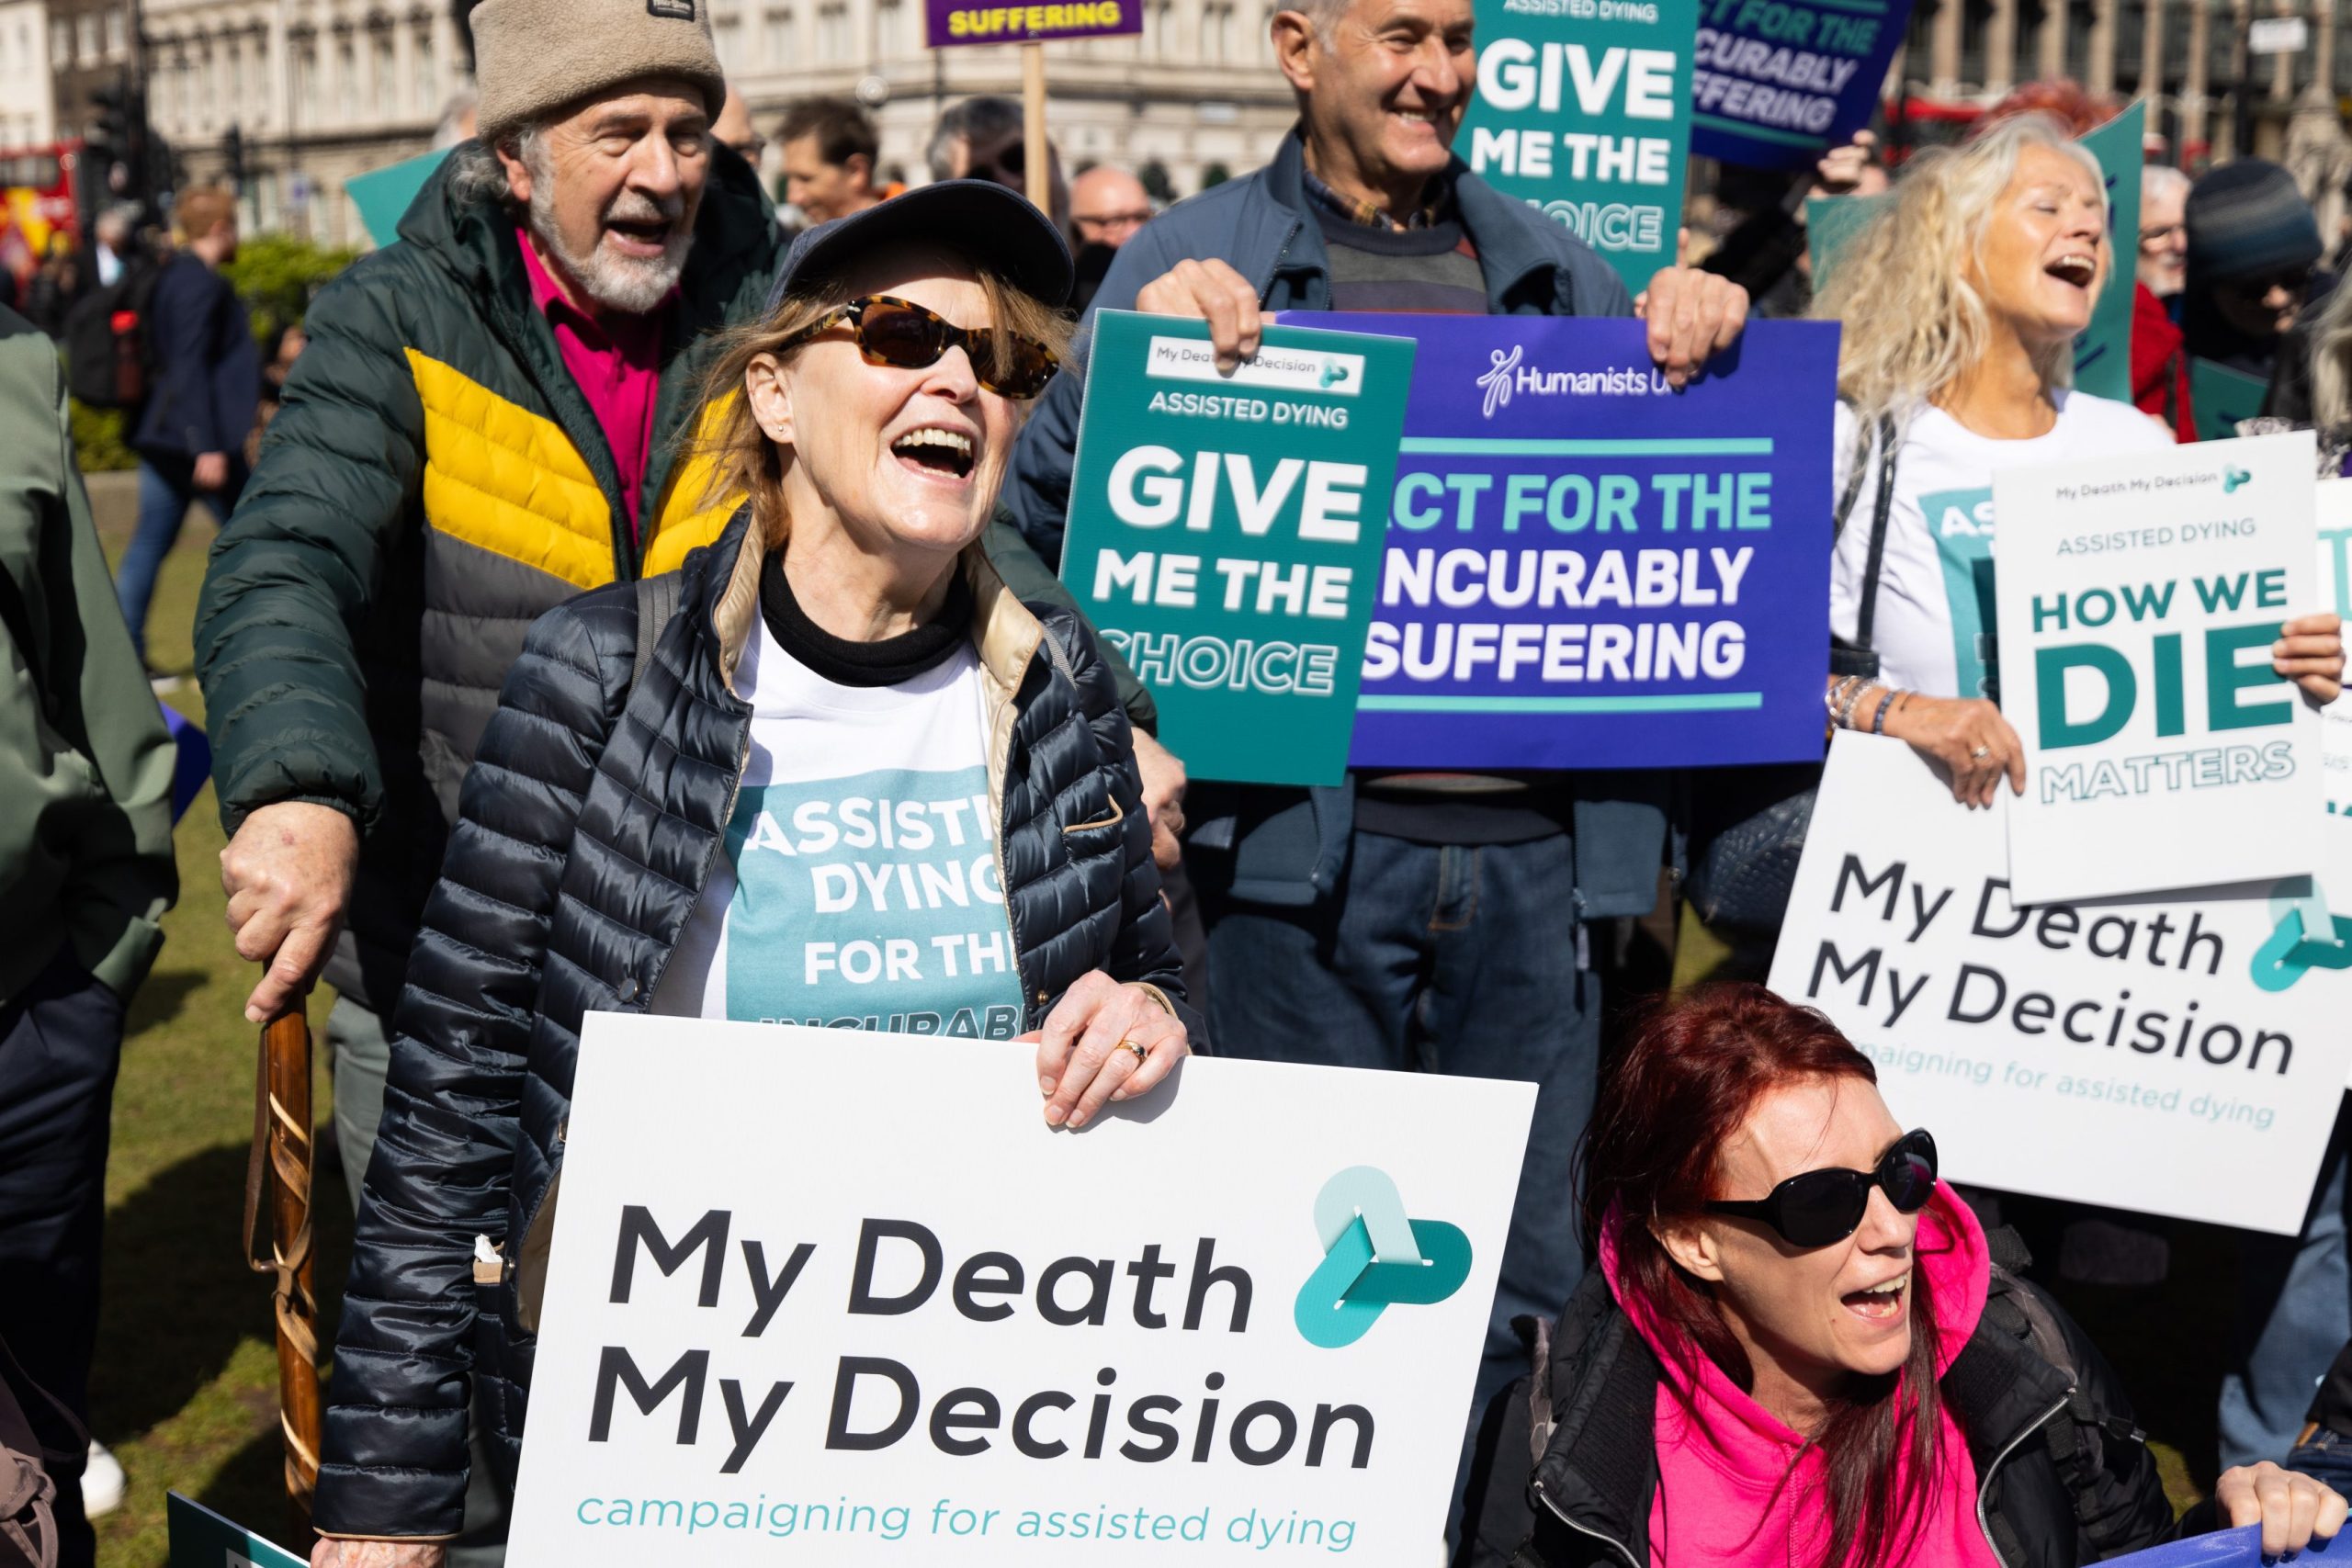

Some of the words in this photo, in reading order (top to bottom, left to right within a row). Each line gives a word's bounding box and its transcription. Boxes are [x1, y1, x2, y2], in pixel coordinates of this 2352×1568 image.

[948, 1, 1122, 36] SUFFERING
[1599, 1, 1659, 24] DYING
[1735, 0, 1815, 45] FOR
[1816, 13, 1880, 55] THE
[1476, 38, 1677, 119] GIVE
[1694, 28, 1859, 93] CURABLY
[1470, 127, 1554, 178] ME
[1564, 132, 1670, 185] THE
[1156, 346, 1177, 362] My
[1182, 348, 1215, 364] Dea
[1253, 355, 1316, 374] Decision
[1517, 366, 1648, 396] Humanists
[1650, 367, 1672, 395] U
[1148, 390, 1268, 420] ASSISTED
[1272, 402, 1349, 428] DYING
[1107, 445, 1368, 543] GIVE
[1386, 471, 1493, 533] CT
[1503, 473, 1640, 533] FOR
[1651, 472, 1772, 531] THE
[2056, 525, 2174, 556] ASSISTED
[2181, 516, 2256, 543] DYING
[1092, 548, 1201, 608] ME
[1216, 558, 1352, 619] THE
[1382, 547, 1755, 608] NCURABLY
[2032, 579, 2177, 633] HOW
[2192, 568, 2287, 615] WE
[1361, 620, 1747, 682] SUFFERING
[2035, 620, 2293, 750] DIE
[2040, 740, 2296, 804] MATTERS
[742, 795, 992, 856] ASSIST
[810, 853, 1004, 913] DYING
[1830, 853, 1954, 943] My
[1971, 876, 2224, 976] Death
[805, 939, 923, 985] FOR
[1806, 940, 1930, 1028] My
[1947, 963, 2294, 1076] Decision
[1860, 1042, 1993, 1085] paigning
[2004, 1060, 2048, 1089] for
[2056, 1070, 2183, 1114] assisted
[2189, 1090, 2275, 1131] dying
[609, 1204, 817, 1337] My
[848, 1217, 1253, 1334] Death
[588, 1346, 795, 1473] My
[824, 1355, 1375, 1469] Decision
[576, 1494, 910, 1540] campaigning
[931, 1498, 1000, 1537] for
[1016, 1504, 1209, 1541] assisted
[1227, 1507, 1356, 1552] dying
